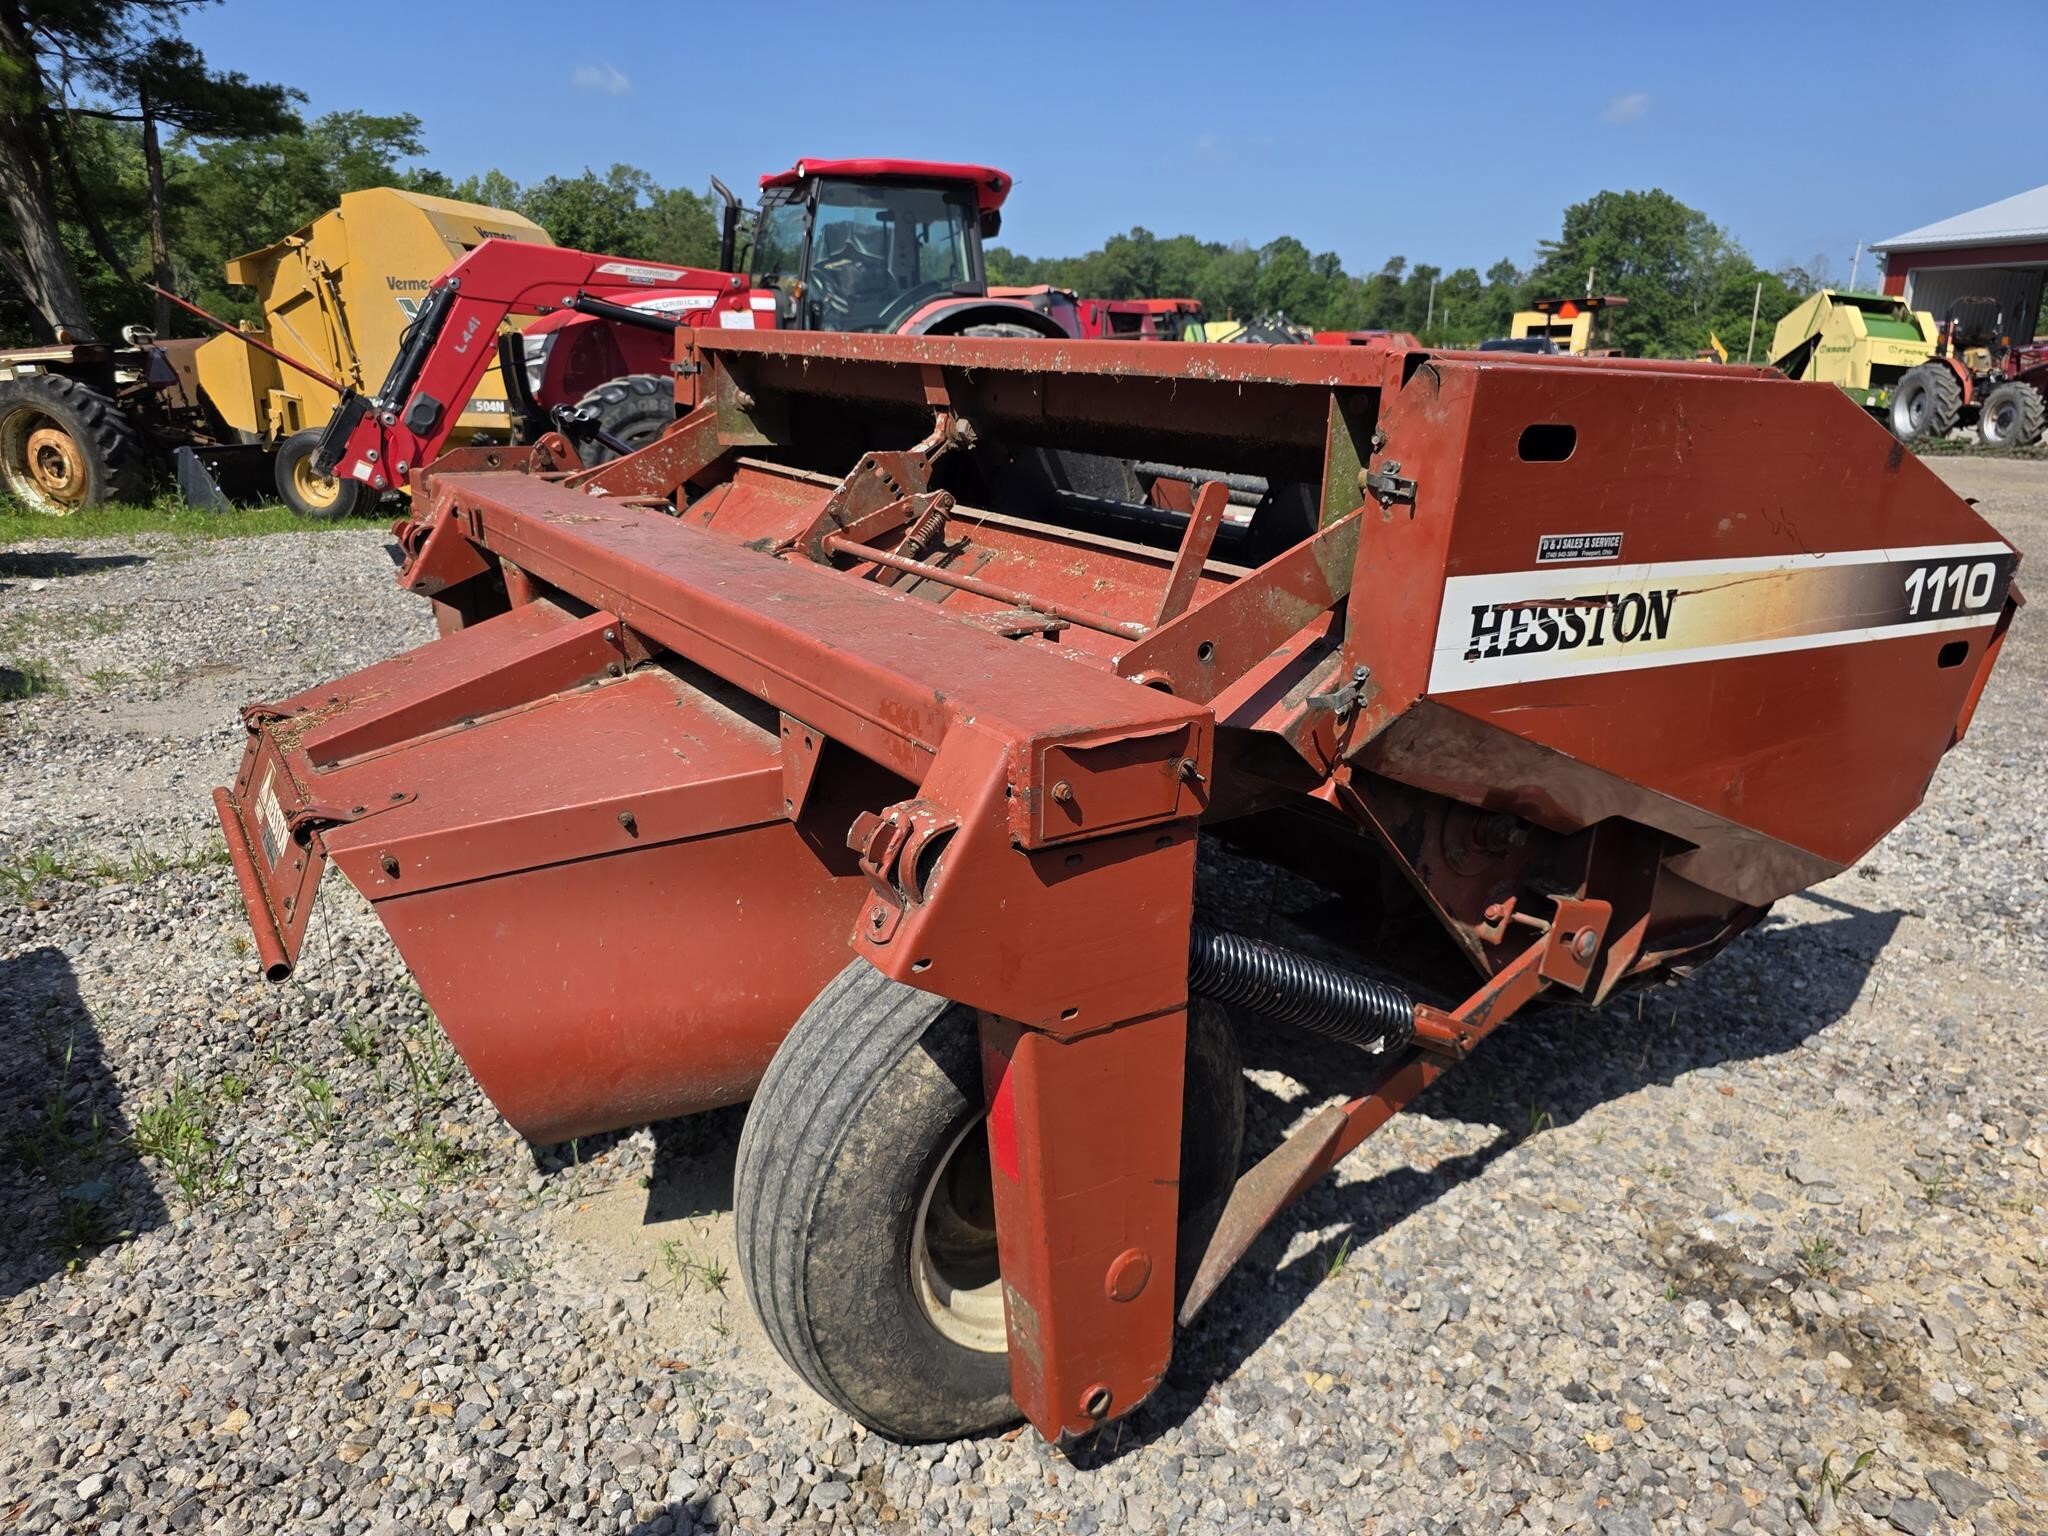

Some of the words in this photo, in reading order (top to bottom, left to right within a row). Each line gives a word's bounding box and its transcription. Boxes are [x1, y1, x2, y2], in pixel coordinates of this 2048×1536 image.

[475, 400, 505, 412] 504N
[1543, 540, 1549, 550] D
[1549, 540, 1555, 549] &
[1556, 539, 1561, 549] J
[1562, 538, 1583, 549] SALES
[1584, 537, 1590, 548] &
[1591, 536, 1620, 548] SERVICE
[1904, 562, 1997, 616] 1110
[1463, 589, 1679, 662] HESSTON
